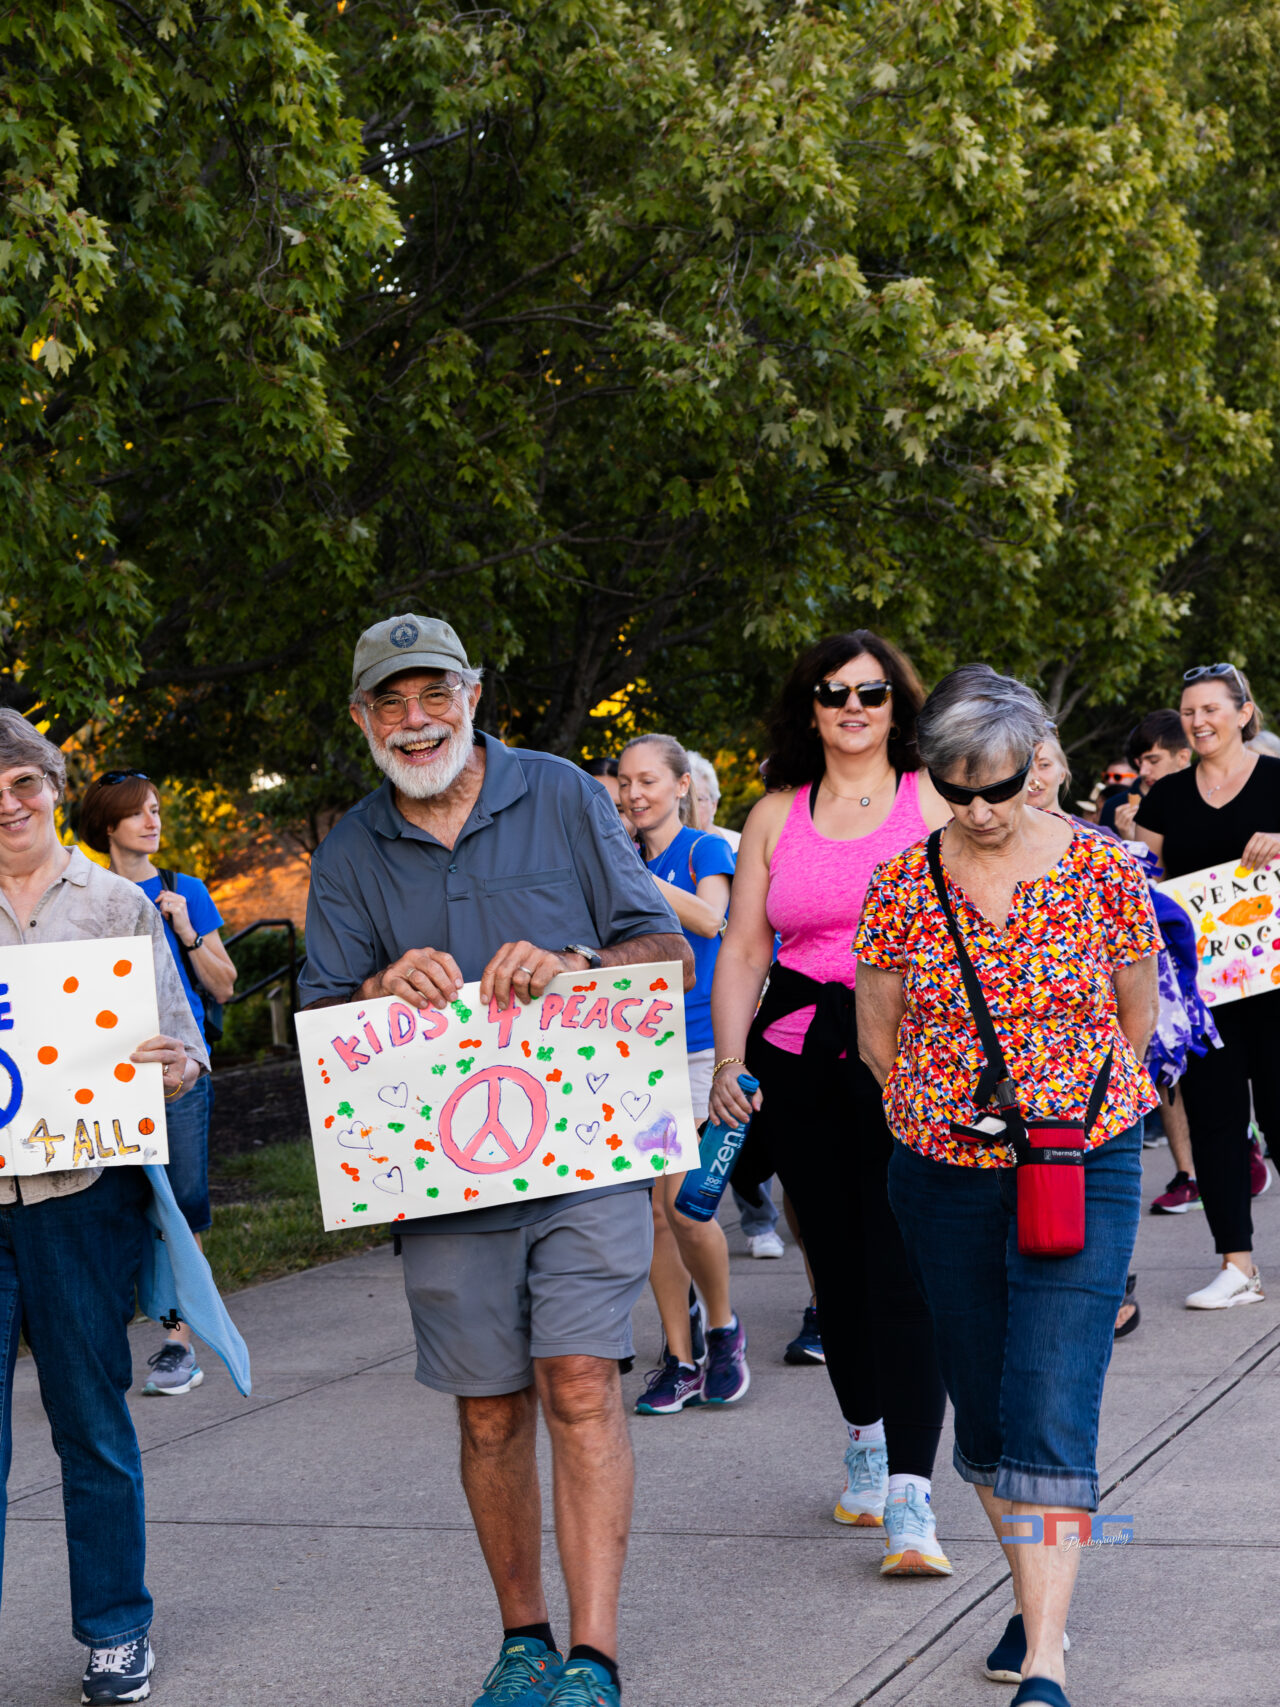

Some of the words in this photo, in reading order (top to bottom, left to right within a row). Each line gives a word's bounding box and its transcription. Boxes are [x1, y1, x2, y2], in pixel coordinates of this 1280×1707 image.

[1209, 921, 1280, 957] ROC
[488, 984, 522, 1049] 4
[539, 993, 673, 1038] PEACE
[28, 1118, 65, 1167] 4
[72, 1119, 140, 1167] ALL
[709, 1131, 743, 1176] zen
